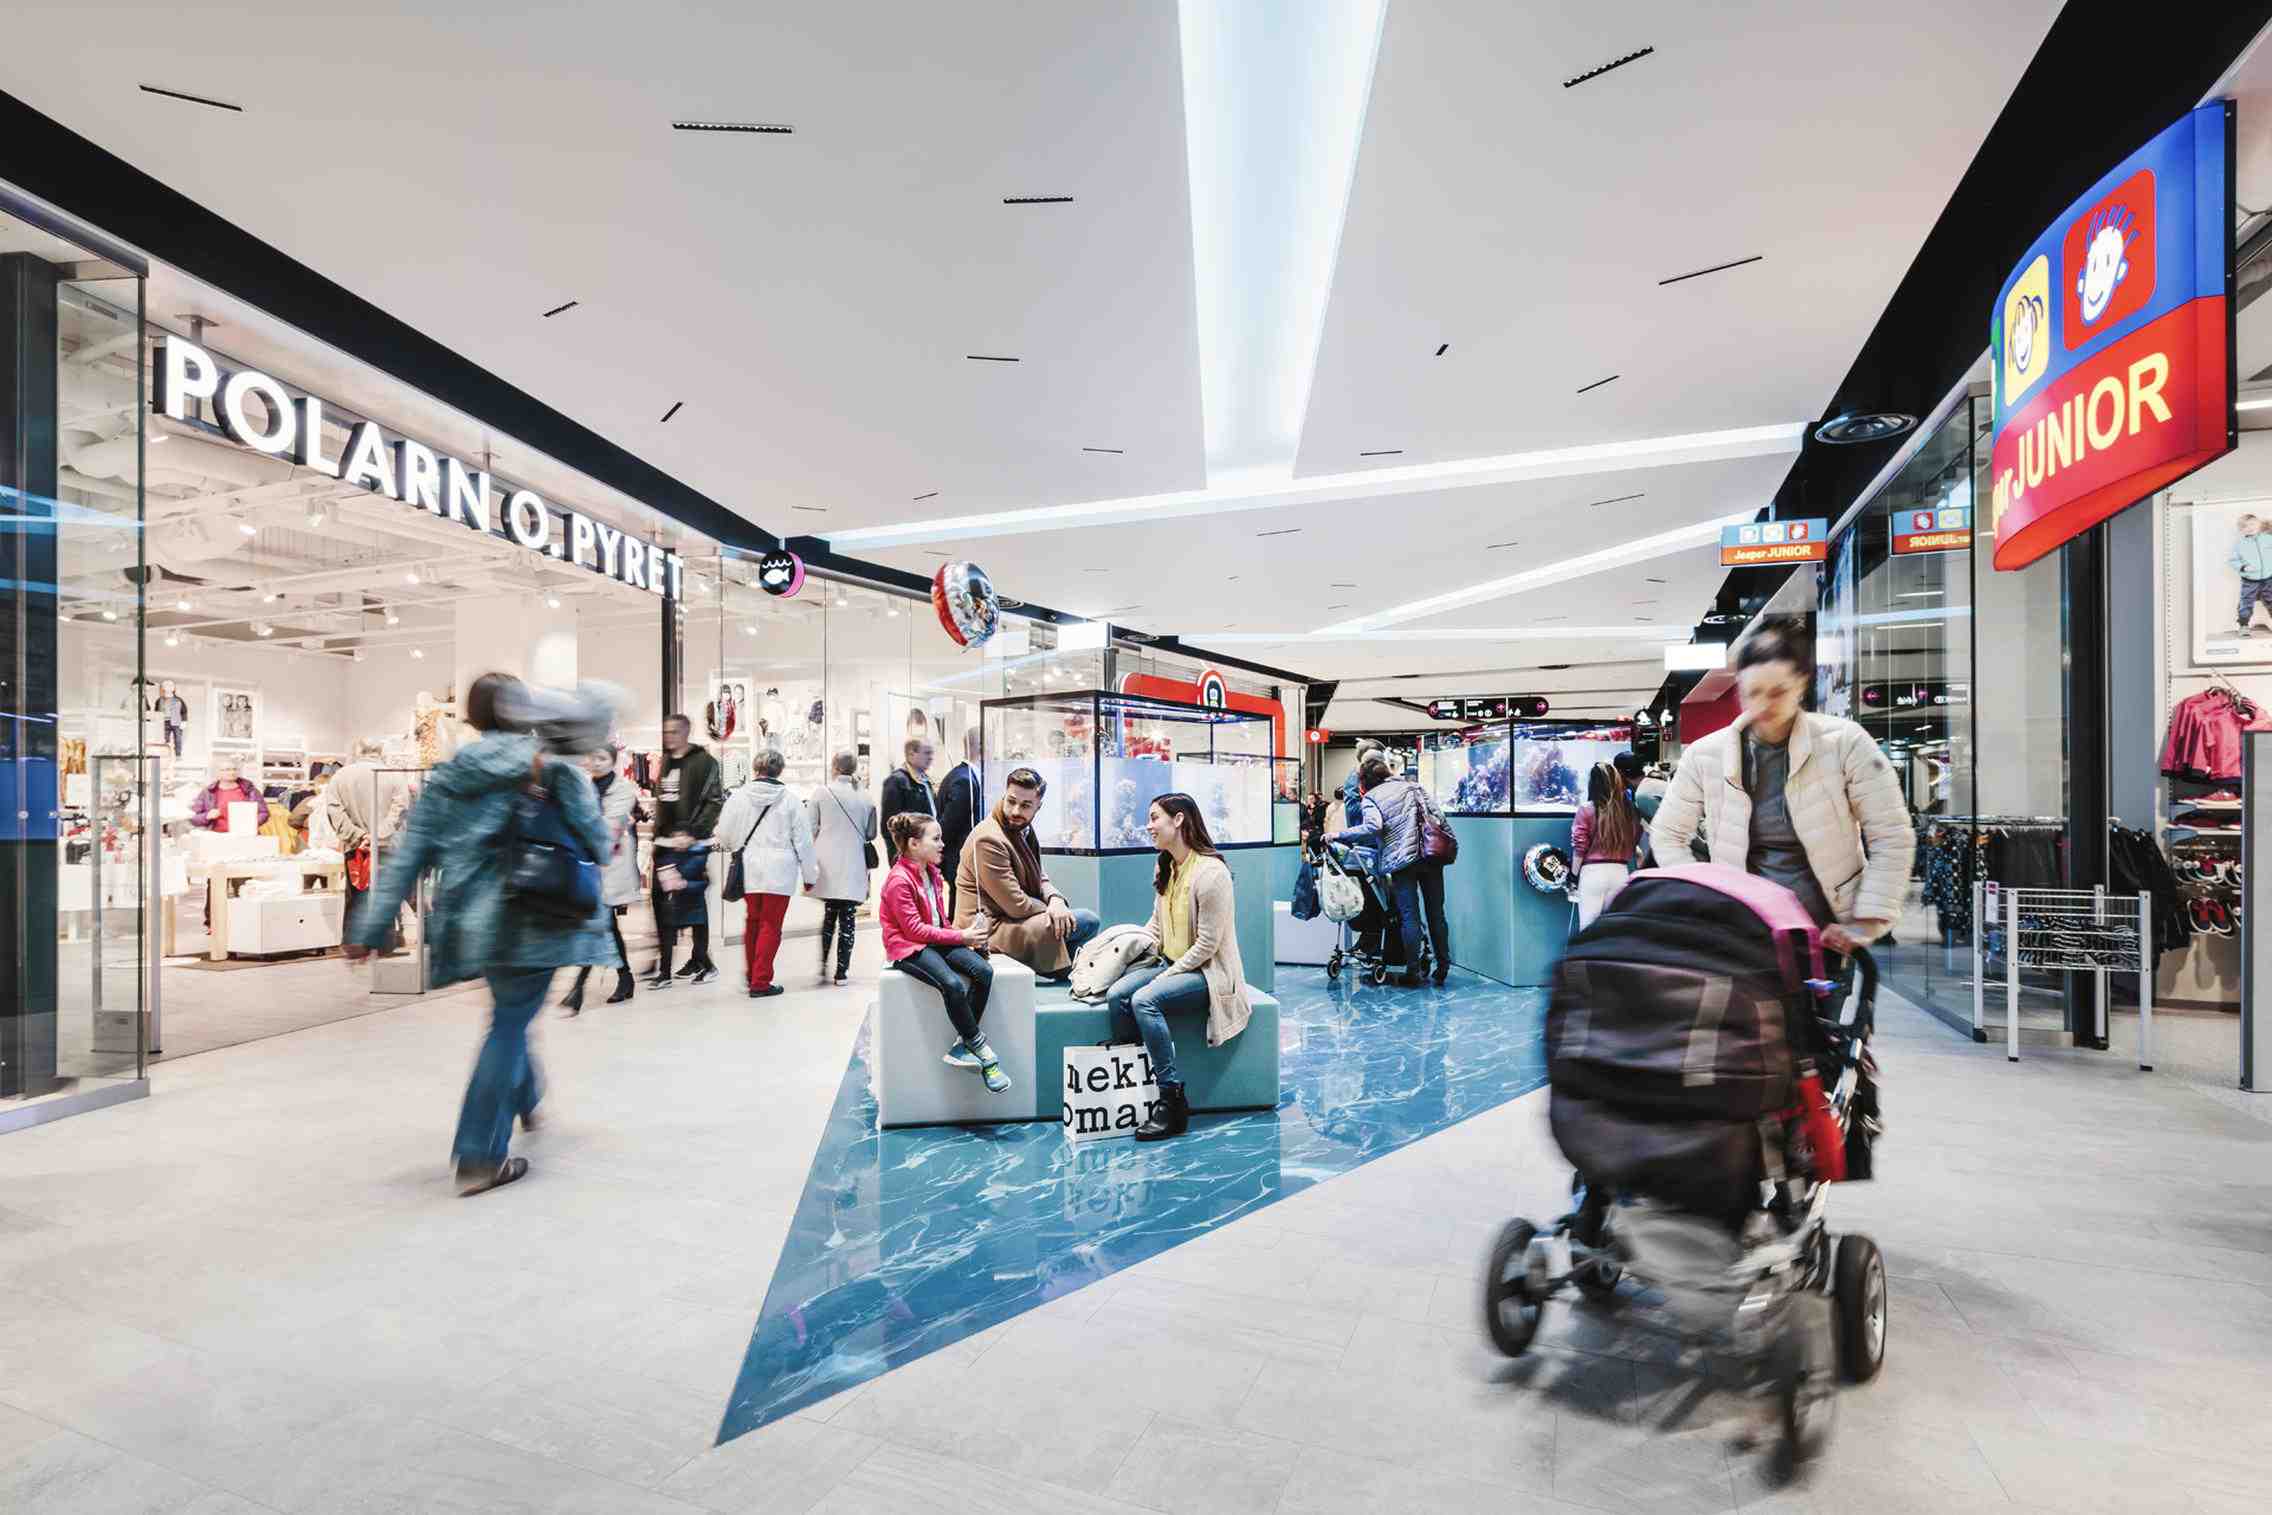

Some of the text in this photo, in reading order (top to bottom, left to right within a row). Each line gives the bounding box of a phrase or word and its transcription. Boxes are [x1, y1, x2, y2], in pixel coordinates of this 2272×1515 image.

[163, 334, 684, 601] POLARN O. PYRET
[2012, 350, 2173, 500] JUNIOR
[1766, 544, 1812, 558] JUNIOR
